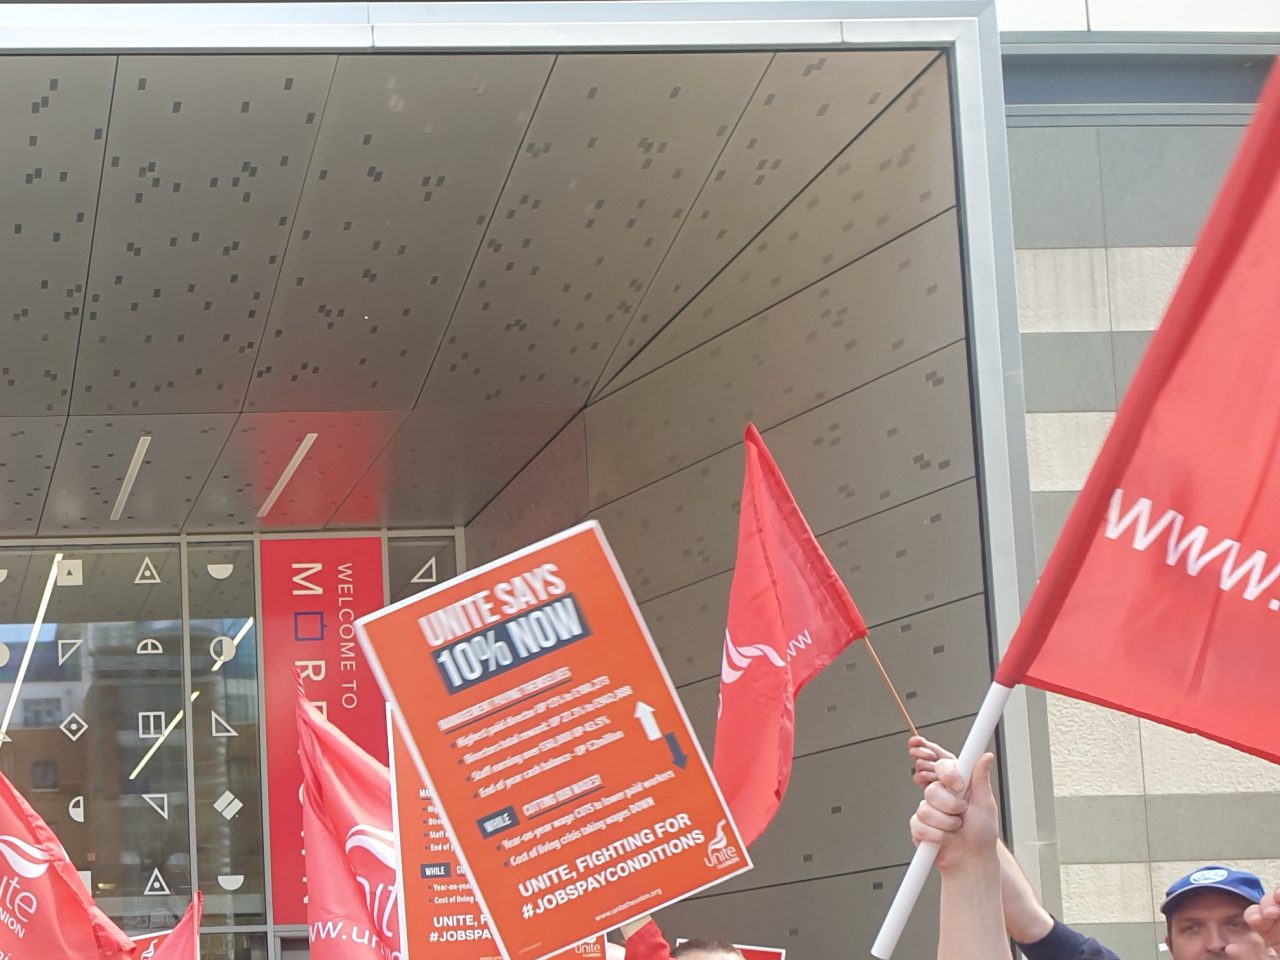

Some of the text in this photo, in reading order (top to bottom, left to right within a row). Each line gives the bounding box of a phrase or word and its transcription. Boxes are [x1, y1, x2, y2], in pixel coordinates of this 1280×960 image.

[337, 563, 357, 710] WELCOME TO
[417, 563, 567, 648] UNITE SAYS
[437, 629, 513, 688] 10%
[505, 597, 583, 659] NOW
[425, 866, 446, 876] WHILE
[518, 813, 692, 898] UNITE, FIGHTING FOR
[521, 829, 705, 919] #JOBSPAYCONDITIONS
[429, 929, 492, 943] #JOBSPA
[433, 914, 477, 928] UNITE,
